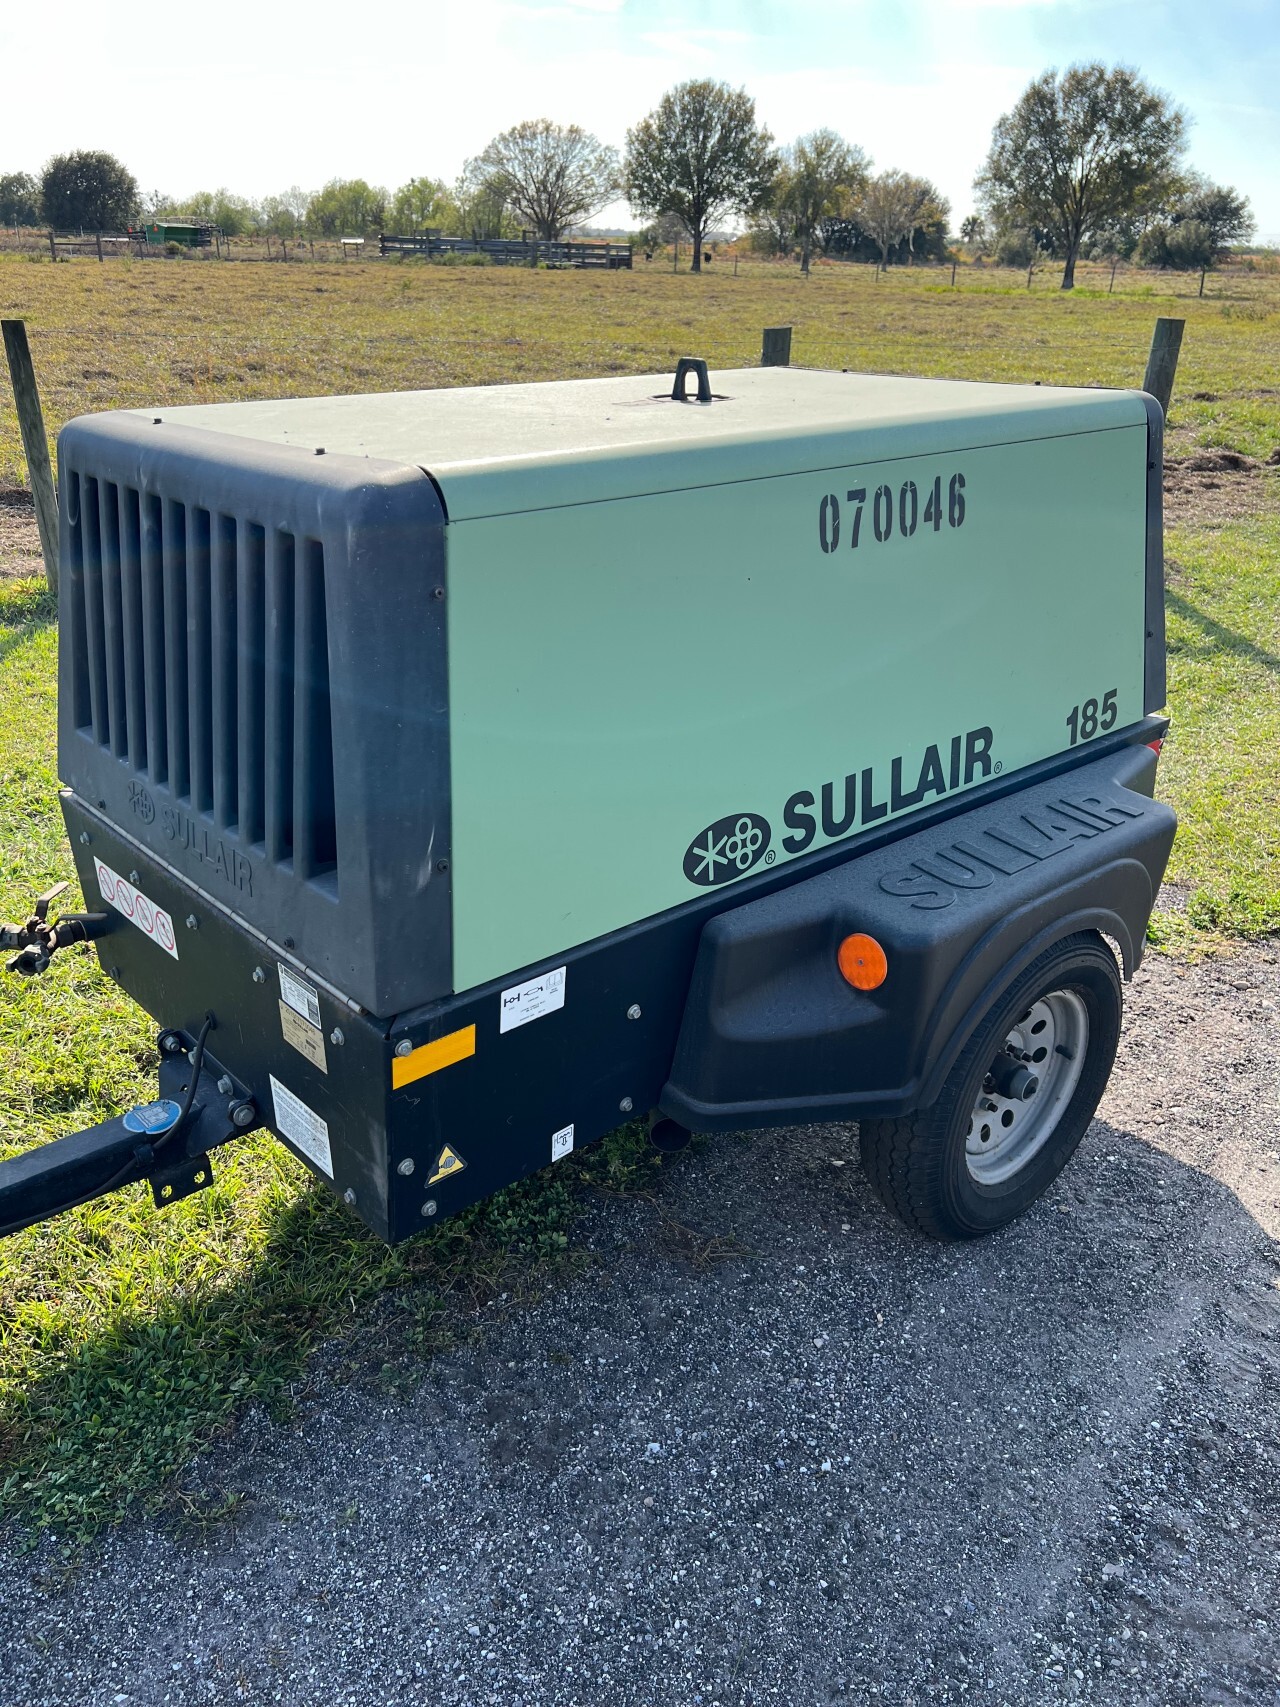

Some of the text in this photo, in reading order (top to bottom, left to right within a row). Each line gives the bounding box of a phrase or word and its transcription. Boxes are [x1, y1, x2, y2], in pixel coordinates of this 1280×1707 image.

[819, 472, 966, 554] 070046
[1066, 688, 1118, 746] 185
[161, 803, 253, 898] SULLAIR
[878, 797, 1145, 911] SULLAIR
